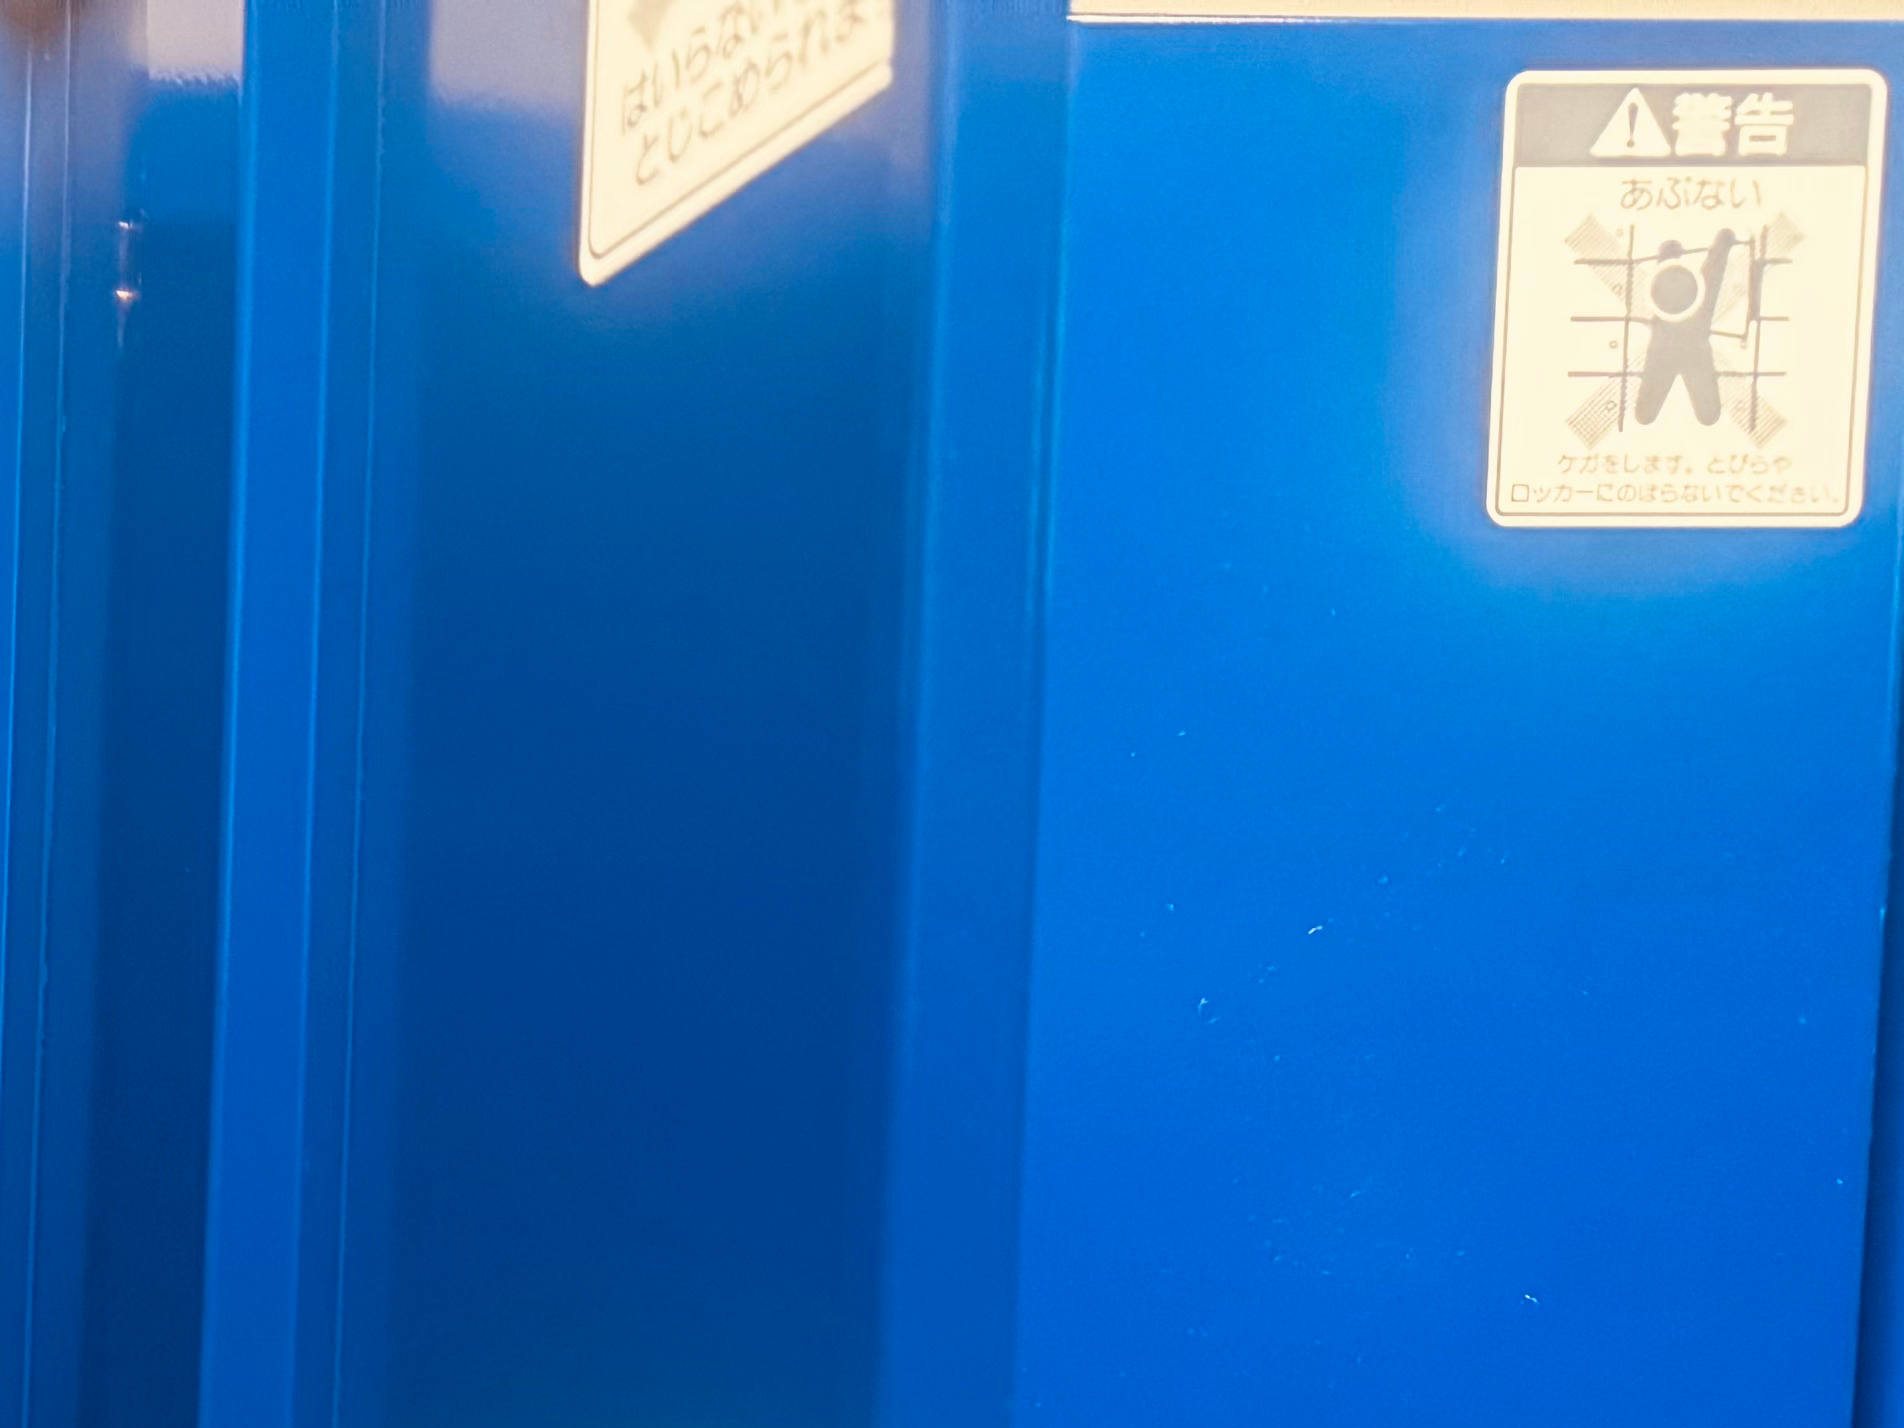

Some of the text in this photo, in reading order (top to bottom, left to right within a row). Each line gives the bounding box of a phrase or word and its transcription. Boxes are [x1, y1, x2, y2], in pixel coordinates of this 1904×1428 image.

[1671, 92, 1794, 157] 警告
[1619, 176, 1763, 211] あぶない
